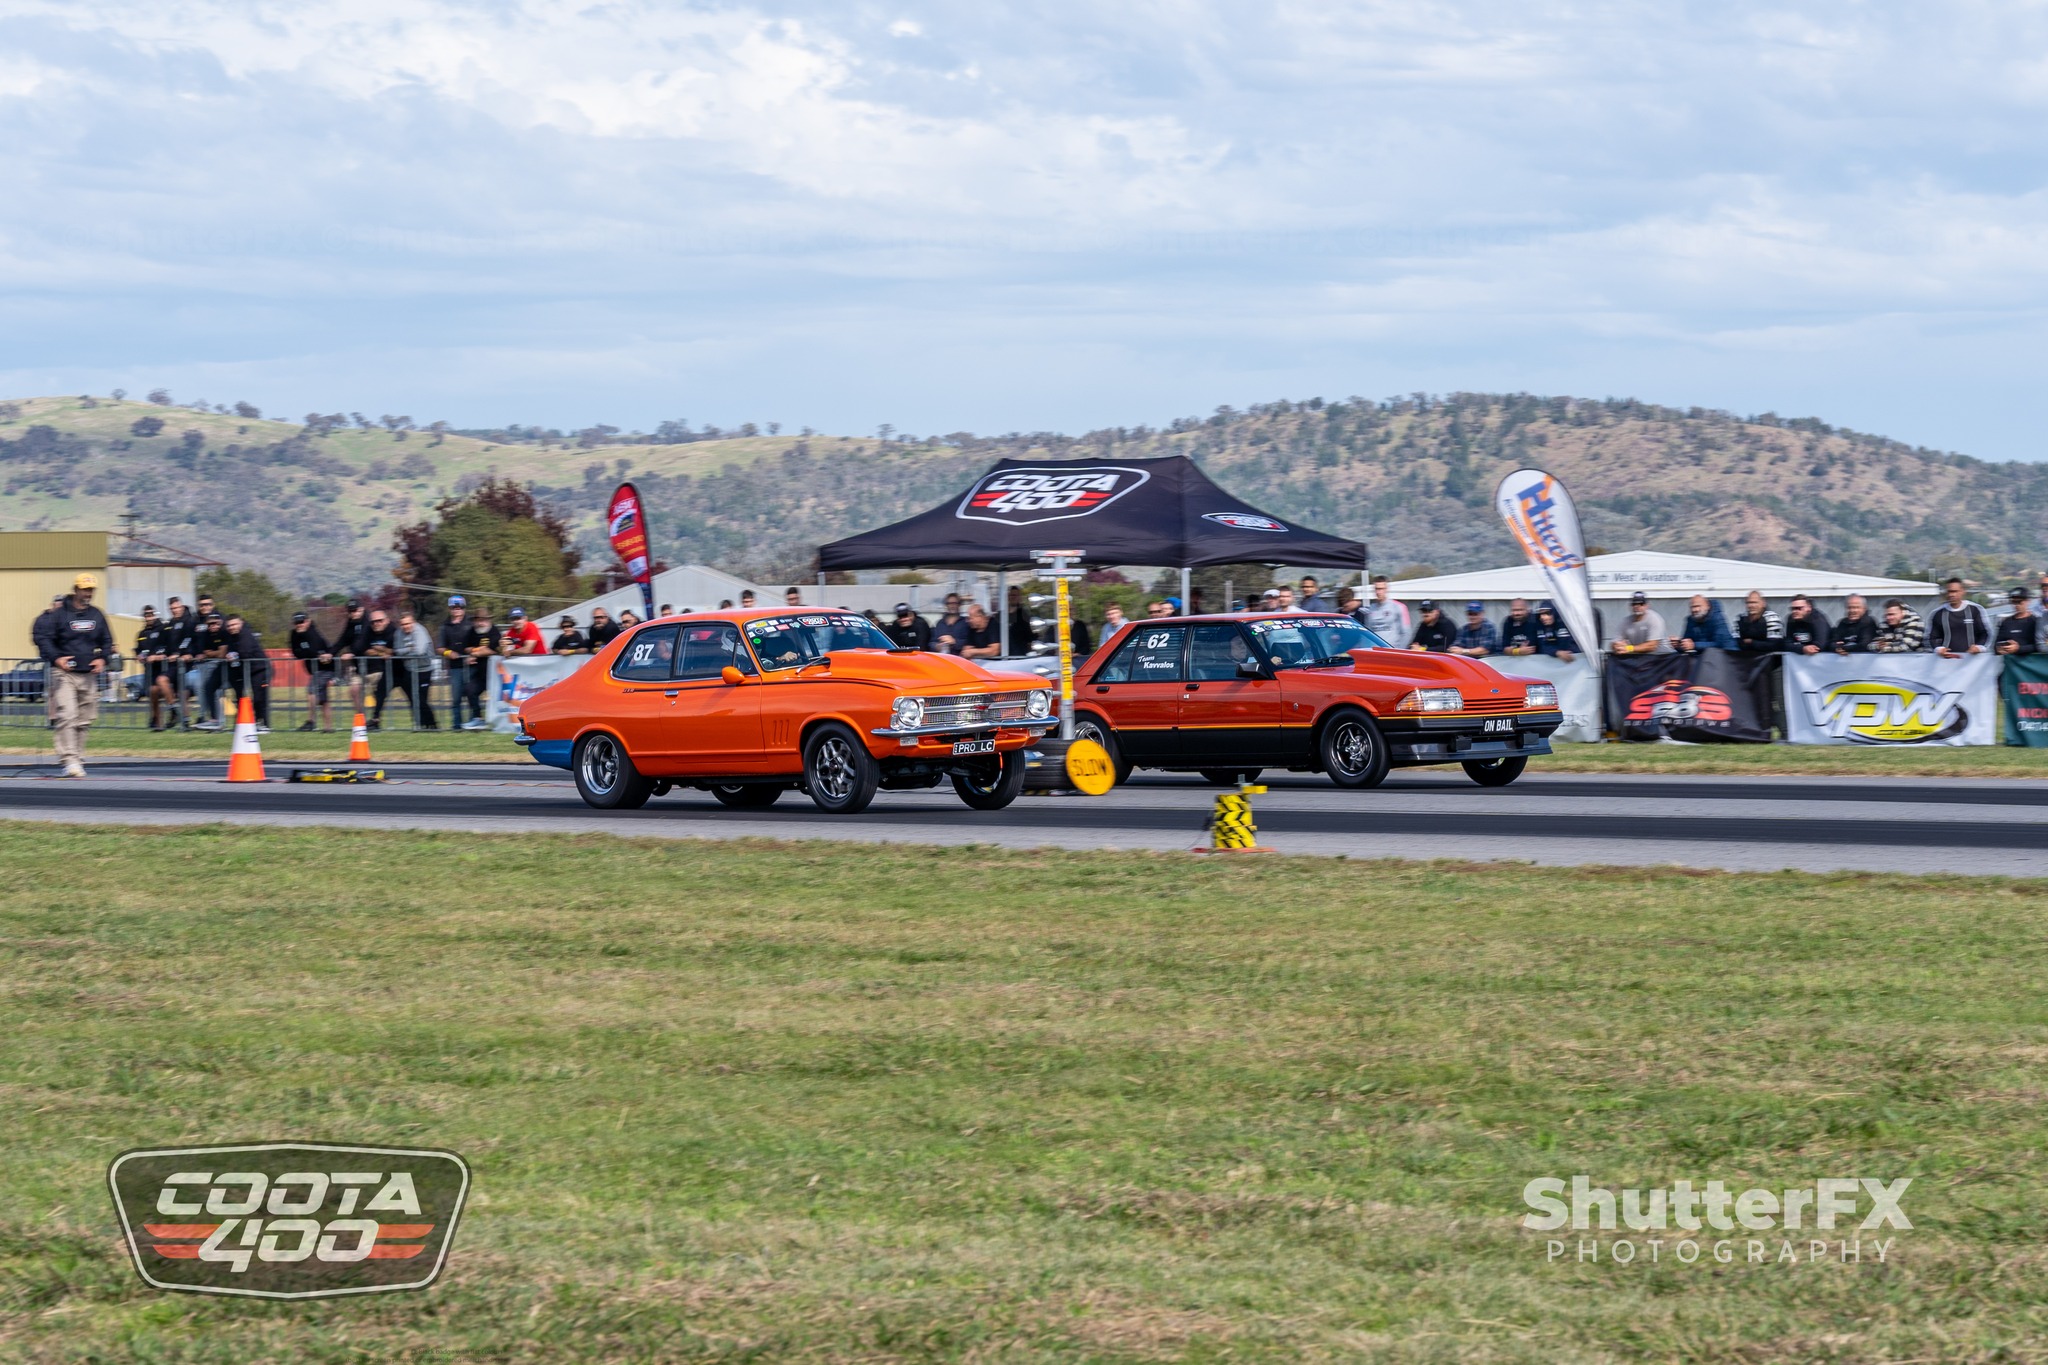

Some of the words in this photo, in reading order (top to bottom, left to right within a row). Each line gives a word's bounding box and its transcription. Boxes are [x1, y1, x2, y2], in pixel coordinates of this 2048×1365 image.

[985, 474, 1120, 491] COOTA
[987, 490, 1087, 513] 400
[1516, 481, 1580, 572] Hitech
[1640, 572, 1680, 582] Aviation
[1147, 633, 1170, 649] 62
[633, 644, 655, 662] 87
[1143, 661, 1174, 669] Kavvalos
[1803, 691, 1965, 738] VPW
[1484, 720, 1495, 731] ON
[1496, 719, 1513, 731] BAIL
[959, 743, 976, 752] PRO
[980, 741, 993, 751] LC
[1071, 758, 1110, 776] SLOW
